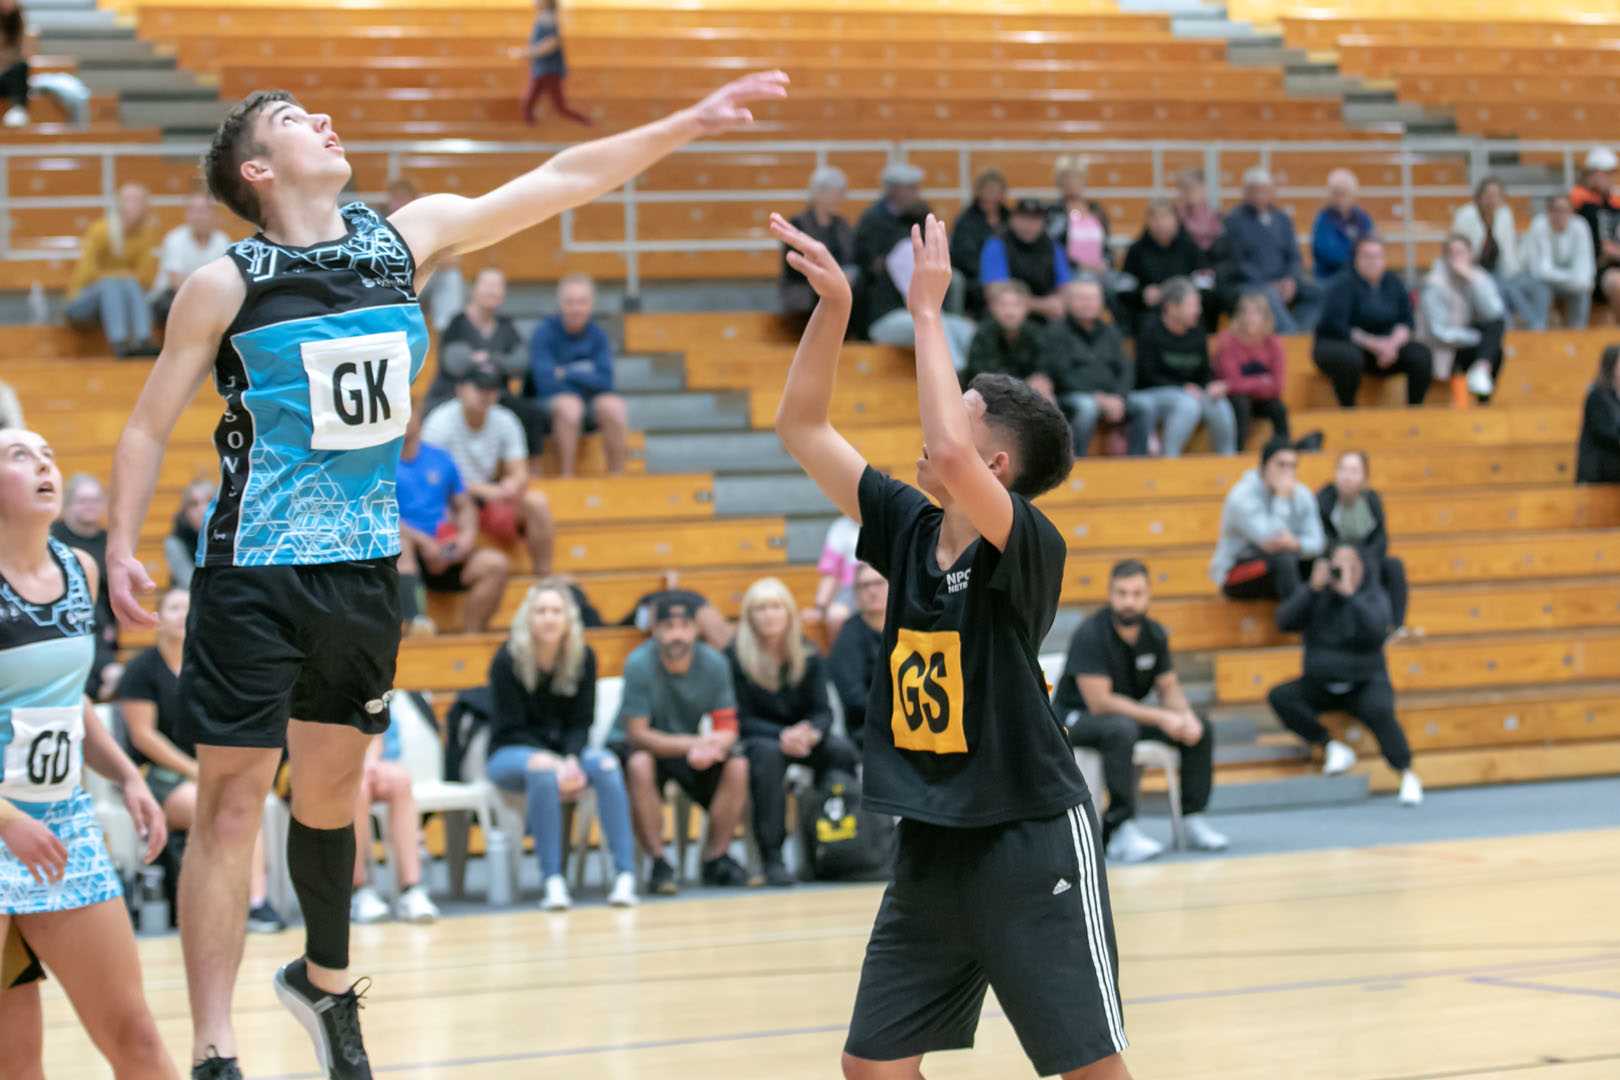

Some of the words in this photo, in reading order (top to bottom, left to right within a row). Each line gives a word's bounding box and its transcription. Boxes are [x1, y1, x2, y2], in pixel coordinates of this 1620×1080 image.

[332, 358, 392, 426] GK
[898, 651, 949, 734] GS
[27, 729, 71, 785] GD
